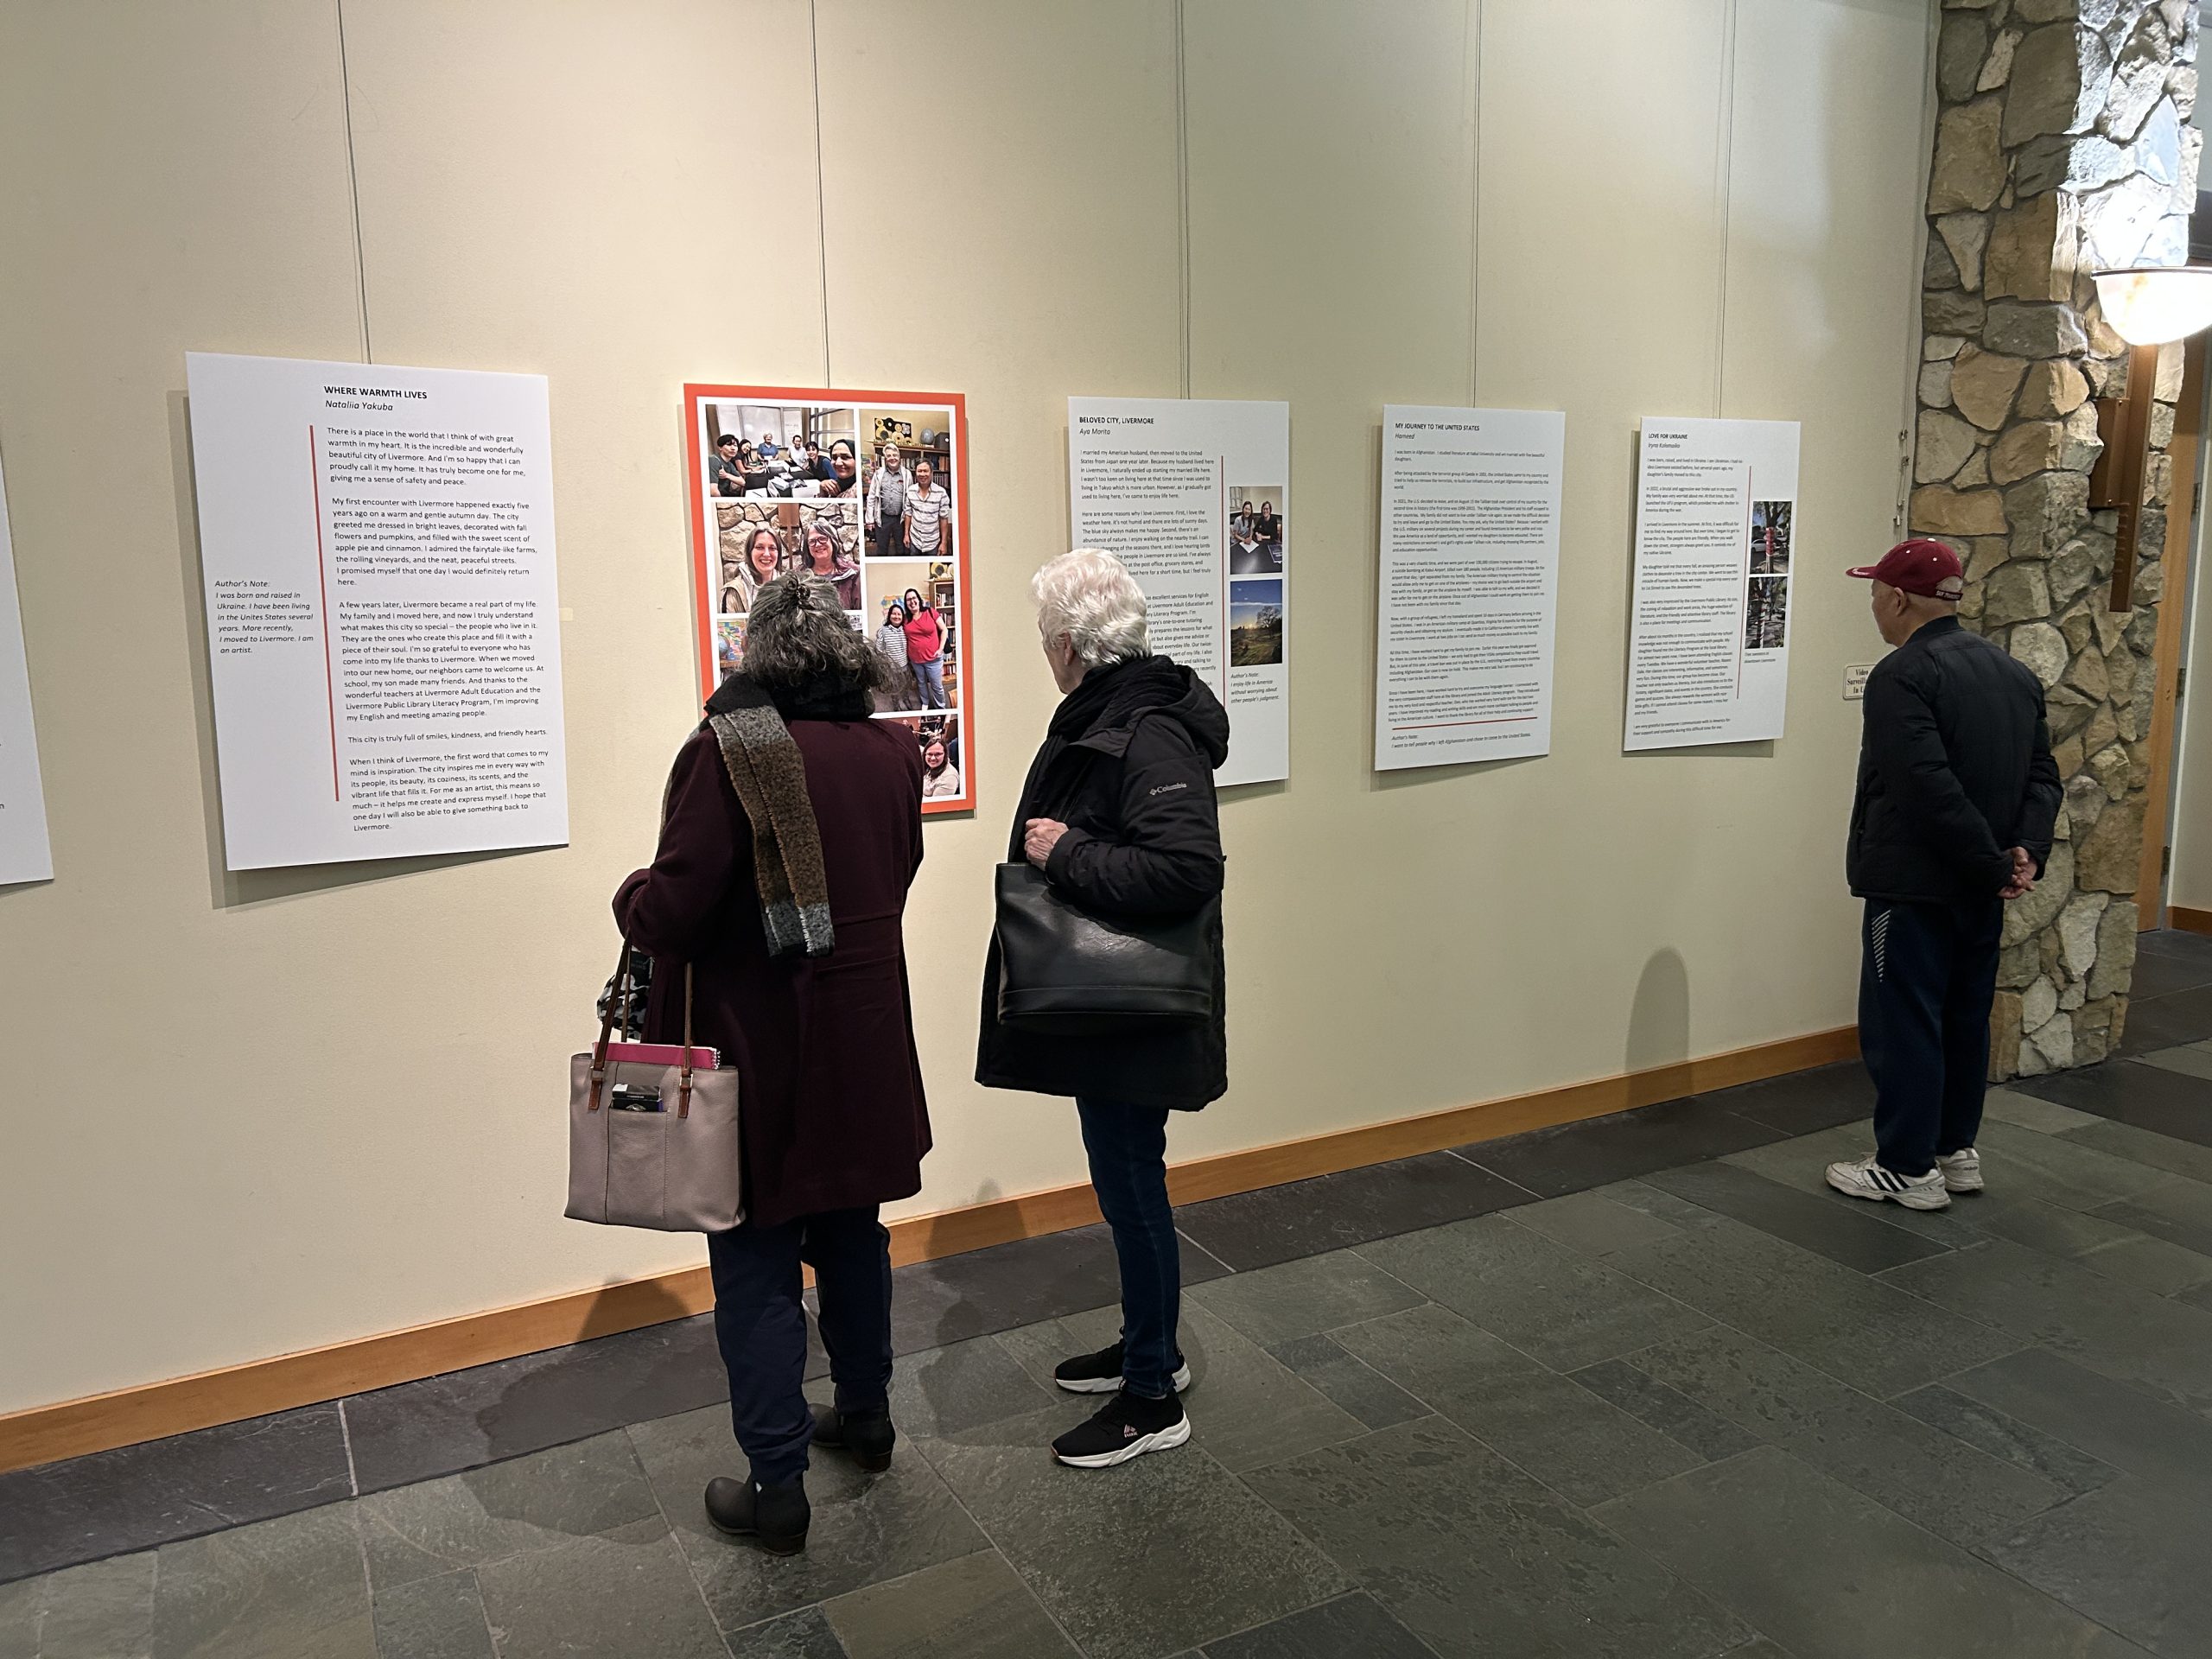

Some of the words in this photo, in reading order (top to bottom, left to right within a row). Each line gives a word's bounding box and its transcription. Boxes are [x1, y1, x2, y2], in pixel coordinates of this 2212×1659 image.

[324, 385, 358, 395] WHERE
[359, 388, 402, 397] WARMTH
[404, 391, 428, 399] LIVES
[326, 400, 359, 410] Nataliia
[362, 402, 393, 411] Yakuba
[327, 427, 349, 435] There
[483, 446, 524, 454] wonderfully
[328, 450, 362, 459] beautiful
[466, 456, 487, 465] happy
[439, 467, 456, 475] truly
[330, 474, 353, 483] giving
[1156, 782, 1187, 793] Columbia
